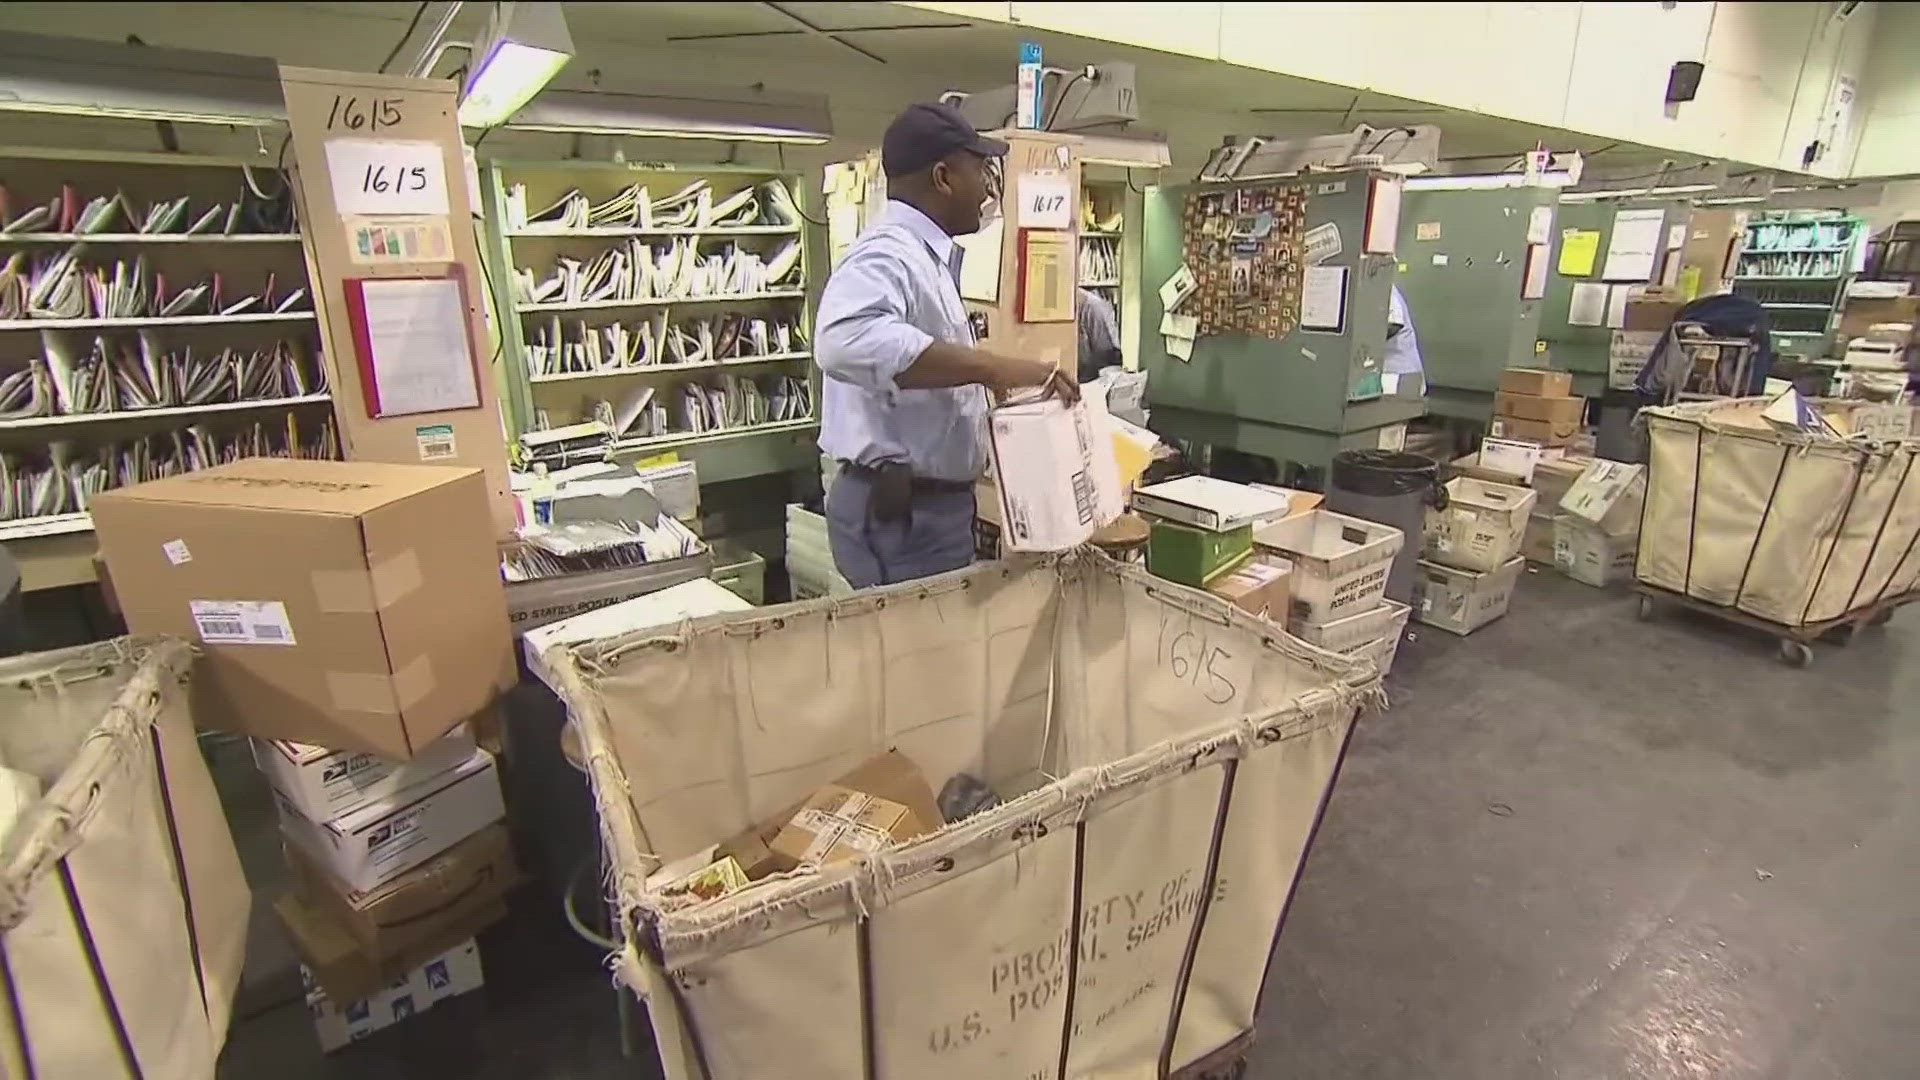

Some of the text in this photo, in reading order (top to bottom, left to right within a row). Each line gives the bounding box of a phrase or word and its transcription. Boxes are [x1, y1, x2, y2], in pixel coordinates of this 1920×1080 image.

[327, 95, 404, 131] 1615
[363, 165, 427, 194] 1615
[1033, 195, 1065, 213] 1617
[1330, 580, 1384, 610] POSTAL SERVICE
[1334, 568, 1385, 596] UNITED STATES
[532, 604, 574, 619] STATES
[577, 596, 619, 611] POSTAL
[1157, 616, 1235, 704] 1615
[992, 868, 1191, 993] PROPRTY OF
[929, 1011, 990, 1052] U.S.
[1009, 934, 1107, 1022] POSAL
